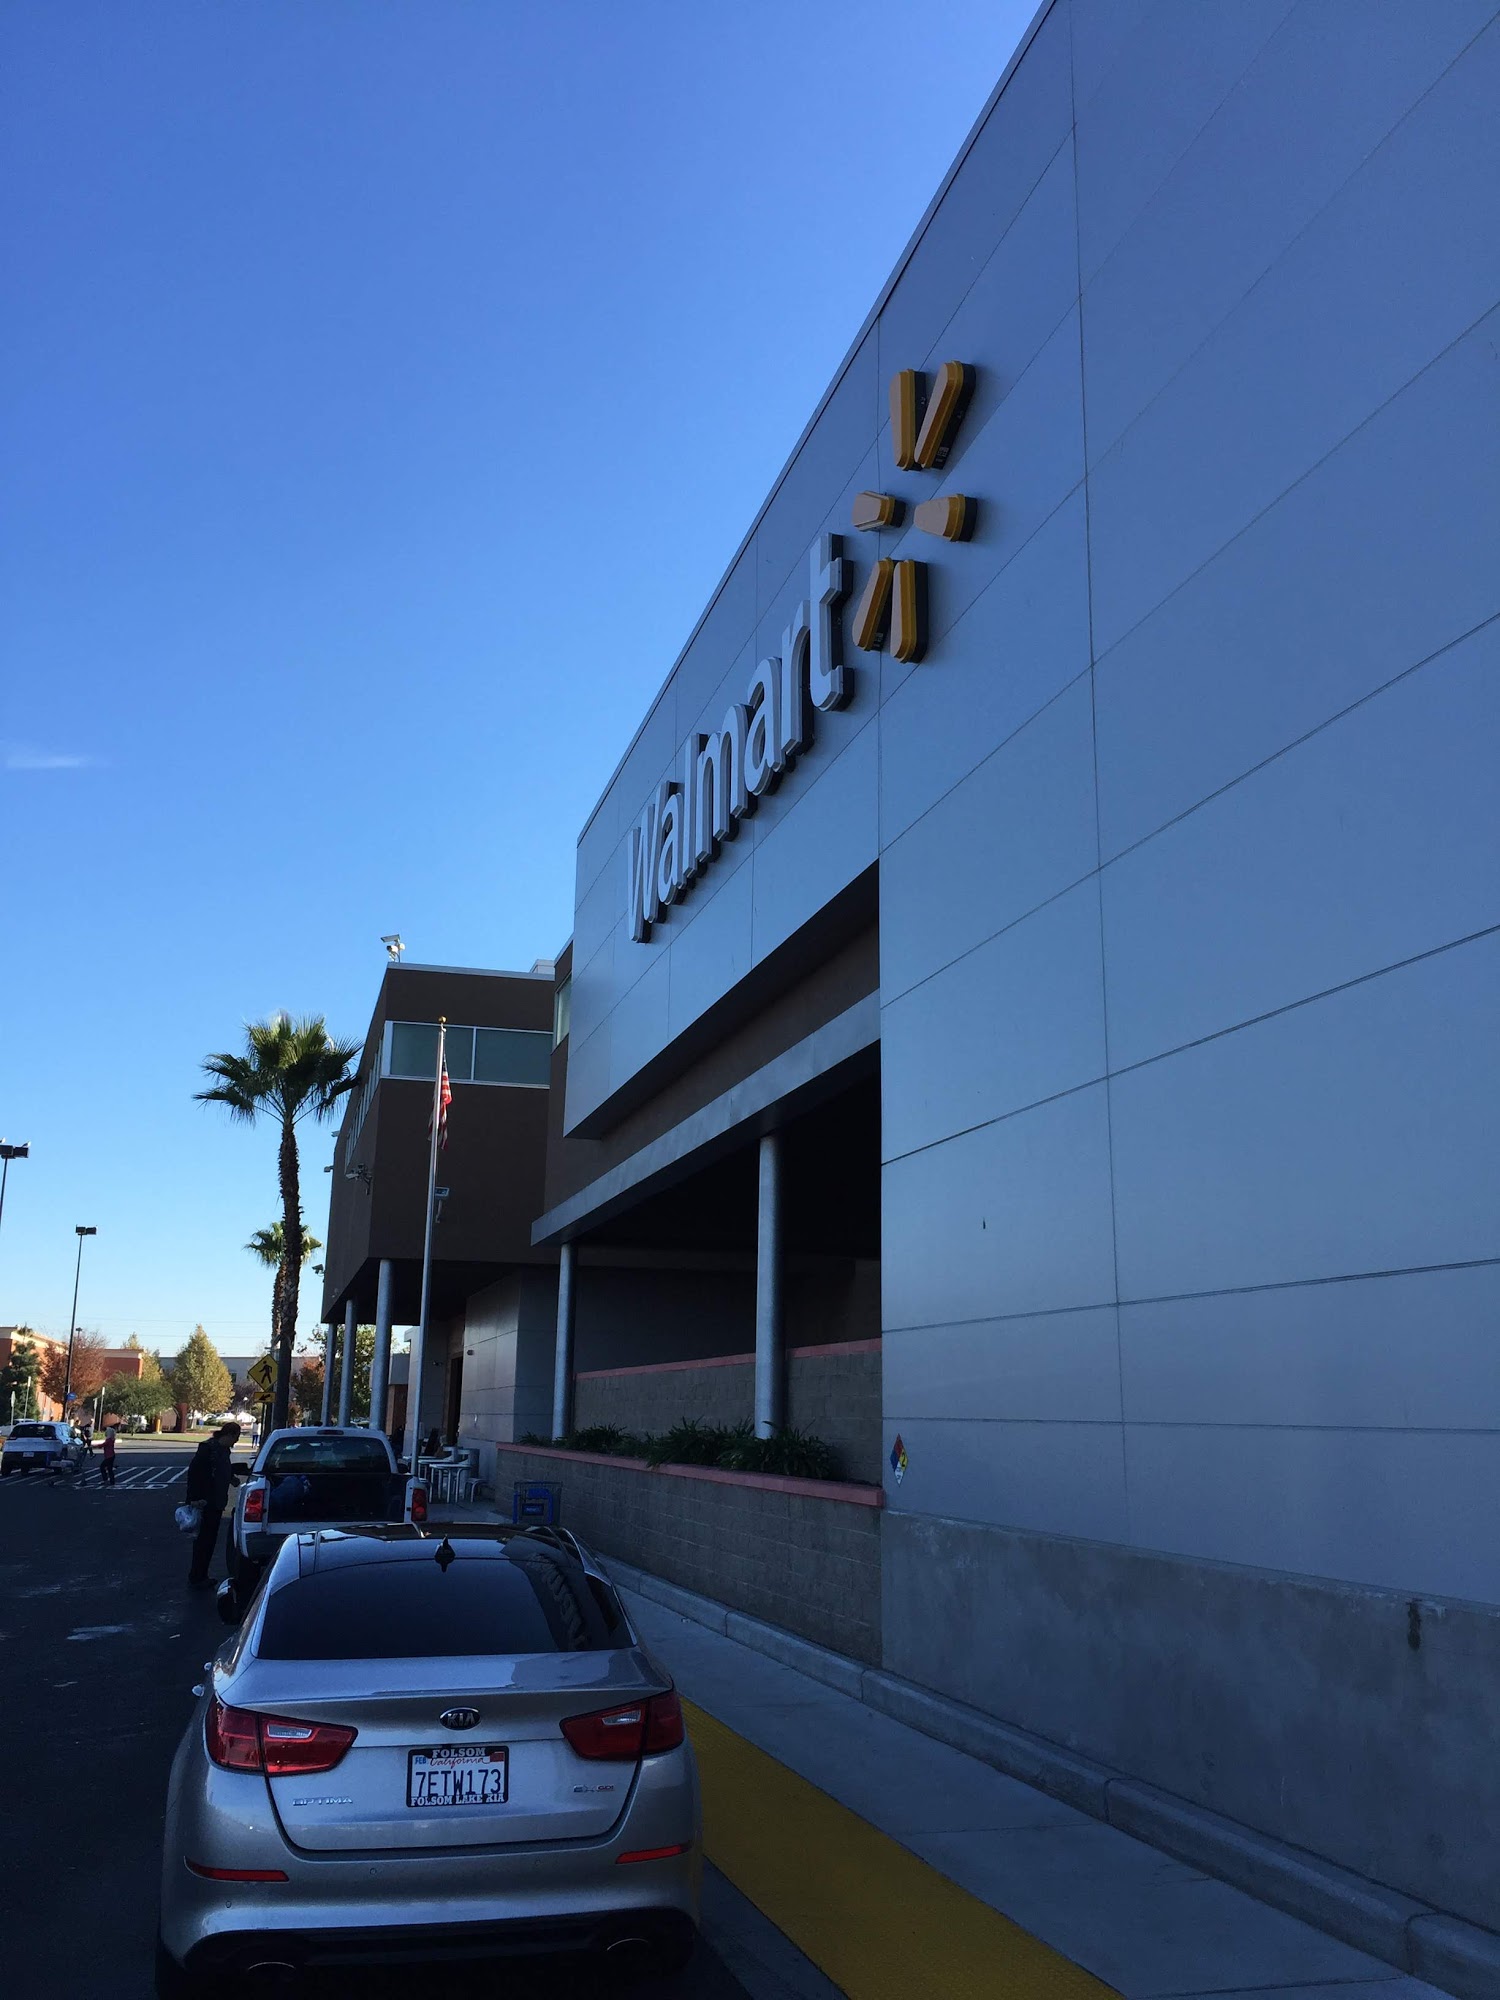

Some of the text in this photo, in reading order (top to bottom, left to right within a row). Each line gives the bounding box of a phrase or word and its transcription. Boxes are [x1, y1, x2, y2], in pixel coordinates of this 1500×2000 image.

[628, 532, 856, 943] Walmart
[447, 1712, 476, 1727] KIA
[432, 1747, 486, 1758] FOLSOM
[414, 1756, 427, 1765] FEB
[415, 1768, 502, 1797] 7ETW173
[292, 1796, 353, 1806] OPTIMA
[410, 1793, 505, 1807] FOLSOM LAKE KIA
